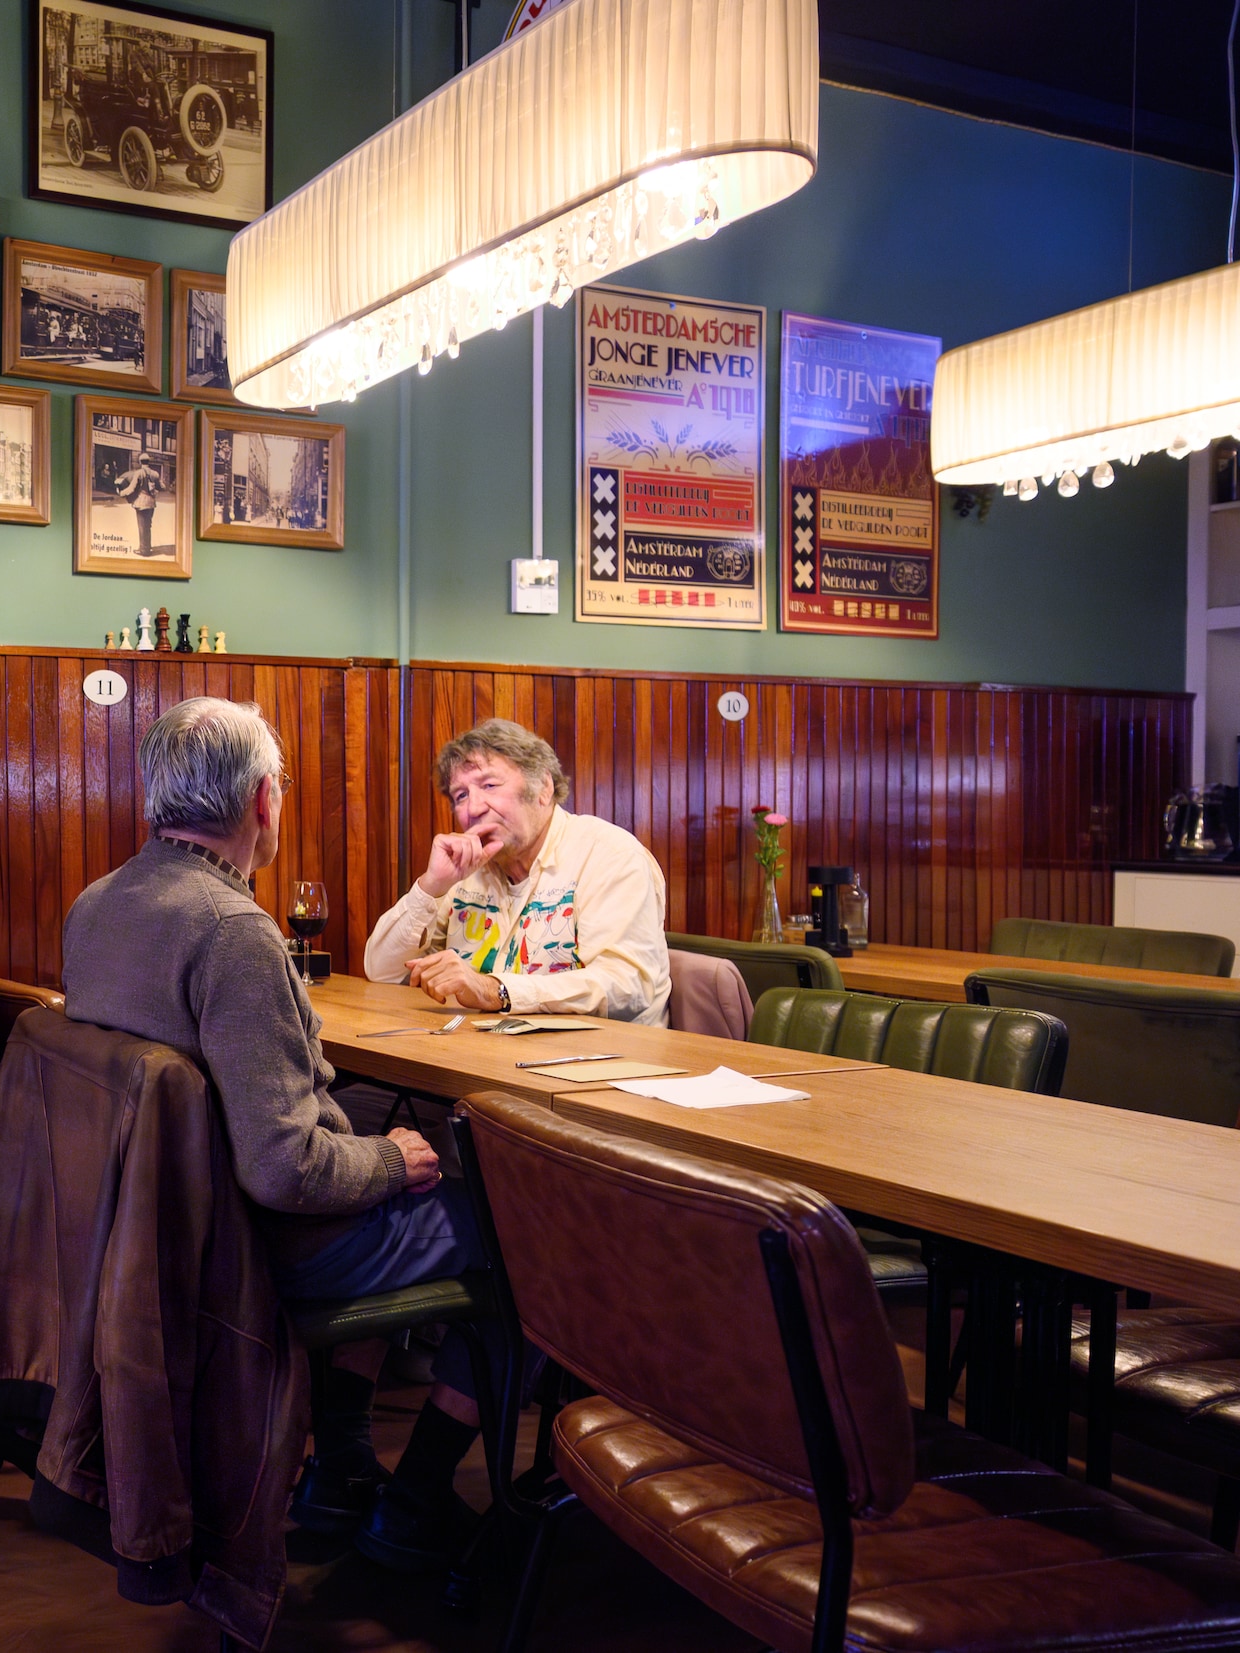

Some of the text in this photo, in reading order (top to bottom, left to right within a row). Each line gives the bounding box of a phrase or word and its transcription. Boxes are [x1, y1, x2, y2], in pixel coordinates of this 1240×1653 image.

[587, 303, 757, 349] AMSTERDAMSCHE
[588, 336, 659, 368] JONGE
[665, 346, 755, 380] JENEVER
[588, 367, 683, 393] GRAANJENEVER
[822, 518, 832, 529] DE
[822, 553, 887, 573] AMSTERDAM
[821, 573, 879, 591] NEDERLAND
[97, 680, 114, 695] 11
[727, 699, 741, 713] 10
